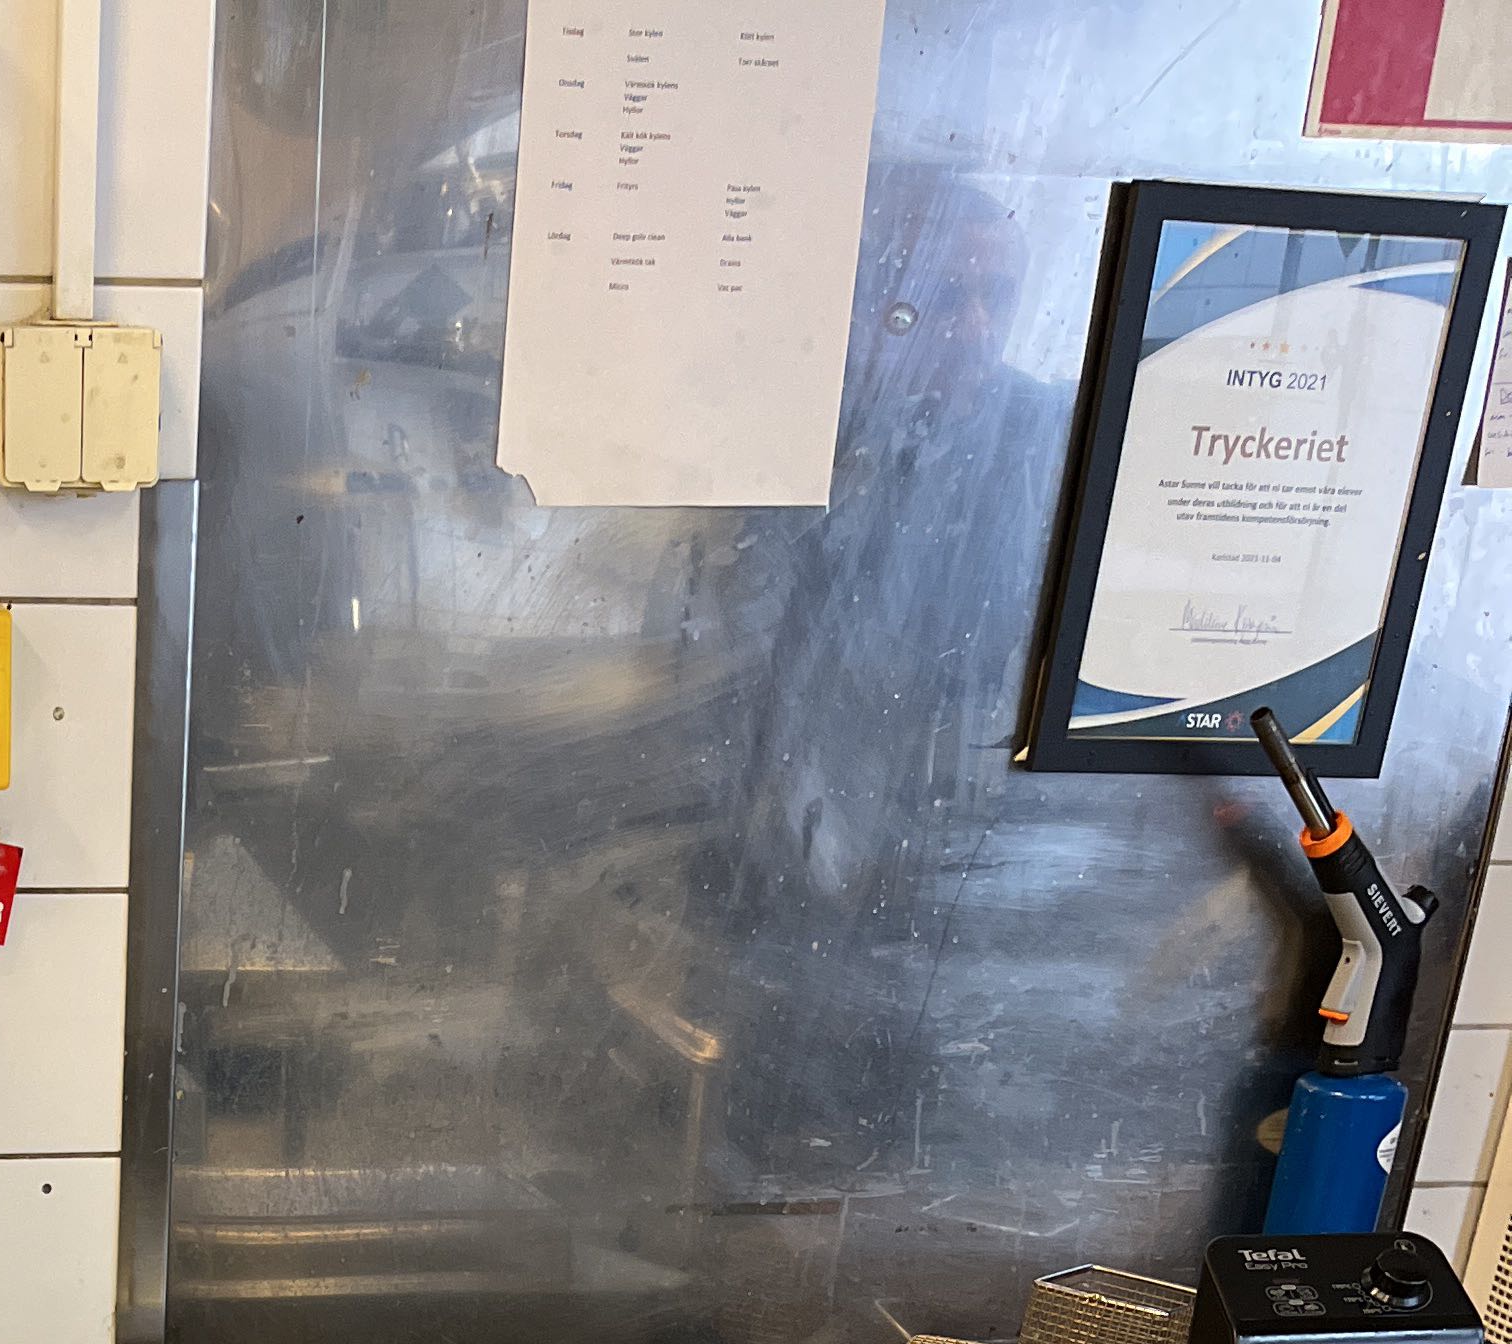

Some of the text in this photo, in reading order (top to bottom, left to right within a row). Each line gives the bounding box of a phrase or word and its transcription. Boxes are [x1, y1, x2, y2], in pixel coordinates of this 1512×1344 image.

[1226, 368, 1327, 392] INTYG 2021
[1190, 424, 1349, 464] Tryckeriet
[1367, 883, 1402, 937] SIEVERT
[1237, 1249, 1307, 1262] Tefal
[1244, 1261, 1308, 1273] Easy Pro
